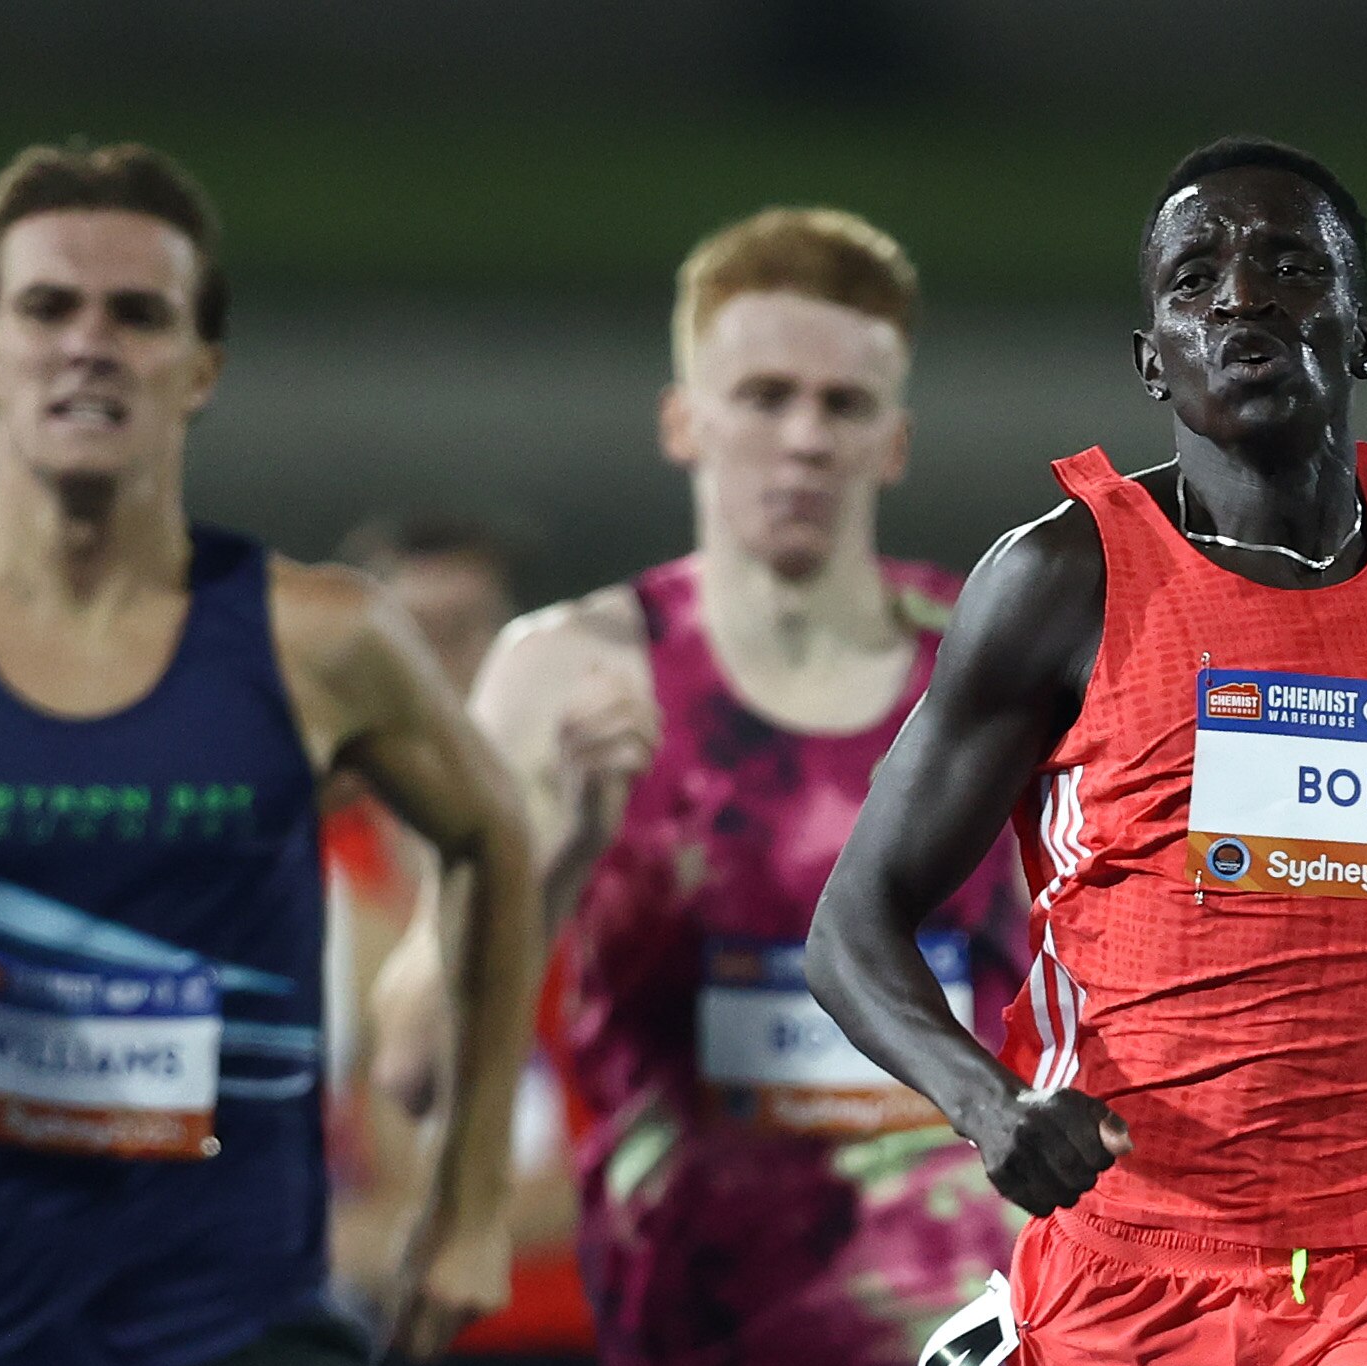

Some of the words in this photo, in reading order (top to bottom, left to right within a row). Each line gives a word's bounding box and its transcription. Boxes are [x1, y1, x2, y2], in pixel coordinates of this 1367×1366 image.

[1210, 694, 1258, 707] CHEMIST
[1268, 685, 1358, 714] CHEMIST
[1268, 710, 1355, 728] WAREHOUSE
